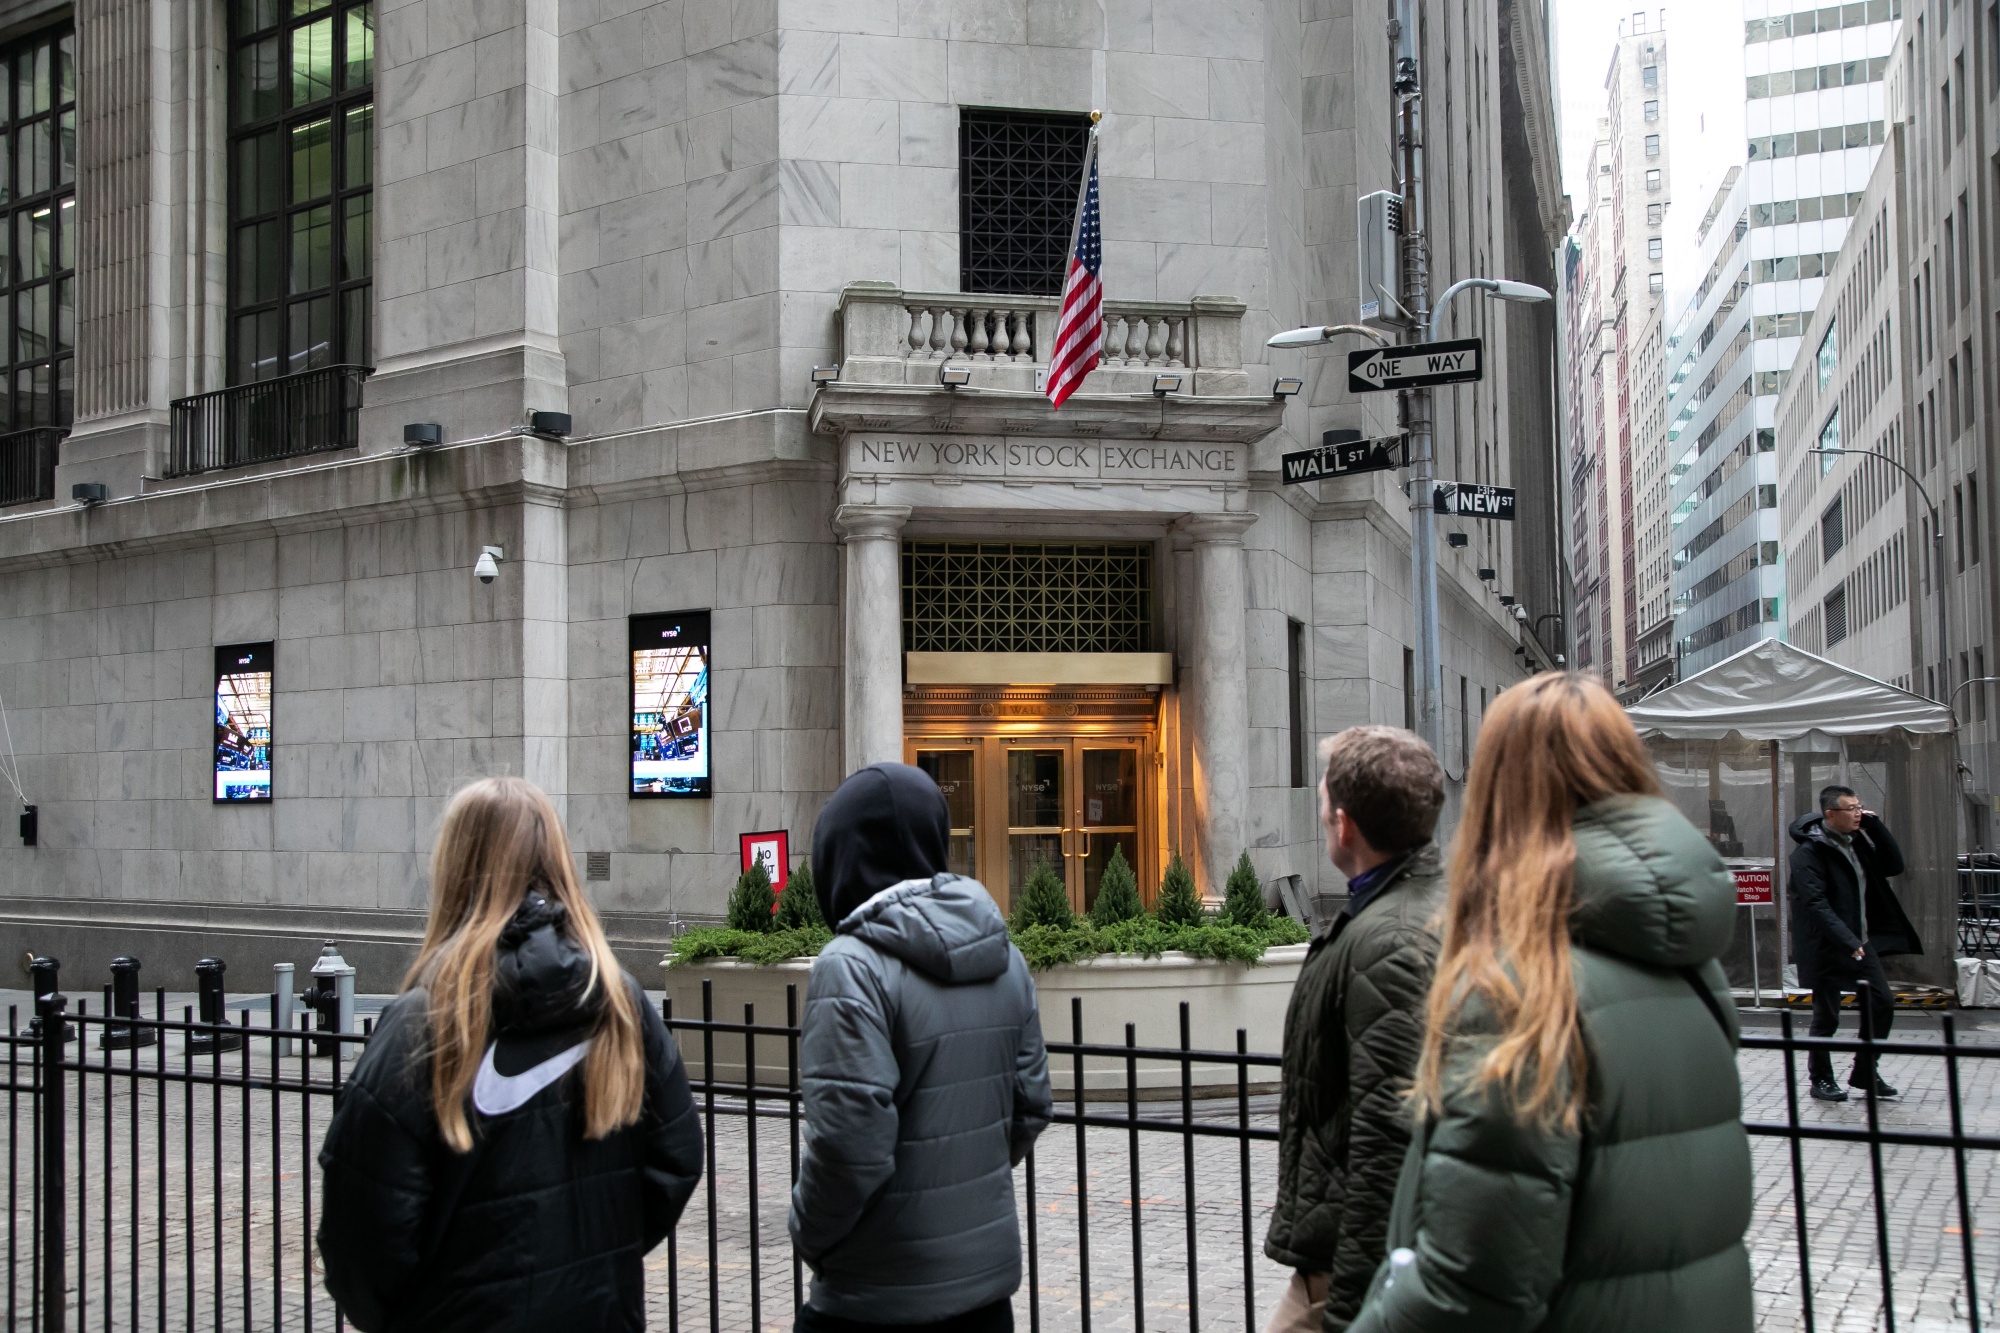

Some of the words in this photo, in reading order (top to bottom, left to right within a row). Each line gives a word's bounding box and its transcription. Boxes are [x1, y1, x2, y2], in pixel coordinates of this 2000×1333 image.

[1366, 360, 1402, 378] ONE
[1427, 353, 1466, 373] WAY
[861, 440, 922, 463] NEW
[928, 442, 1000, 466] YORK
[1008, 444, 1091, 467] STOCK
[1104, 447, 1235, 471] EXCHANGE
[1320, 446, 1338, 456] 9-15
[1287, 453, 1348, 479] WALL
[1348, 449, 1365, 462] ST
[1477, 486, 1490, 495] 1-31
[1460, 492, 1501, 514] NEW
[1501, 496, 1514, 506] ST
[1010, 705, 1043, 715] WALL
